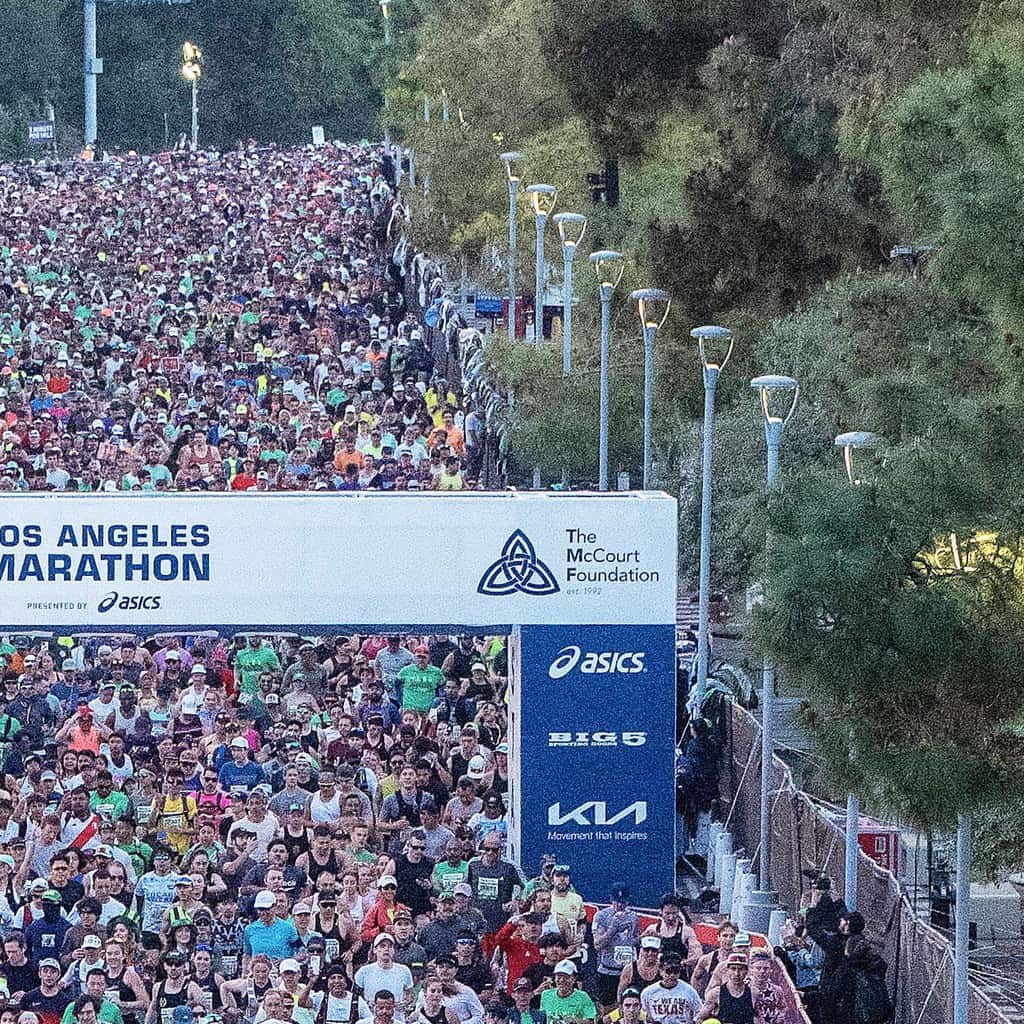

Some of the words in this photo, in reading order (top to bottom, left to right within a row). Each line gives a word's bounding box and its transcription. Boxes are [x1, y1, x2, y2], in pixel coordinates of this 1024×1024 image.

[57, 524, 210, 547] ANGELES
[566, 528, 597, 544] The
[566, 548, 640, 563] McCourt
[566, 567, 660, 582] Foundation
[583, 588, 602, 596] 1992
[27, 602, 75, 610] PRESENTED
[77, 602, 88, 610] BY
[548, 732, 618, 742] BIG
[622, 732, 648, 746] 5
[548, 801, 648, 826] KIA
[548, 831, 593, 841] Movement
[595, 831, 612, 840] that
[615, 831, 648, 842] inspires
